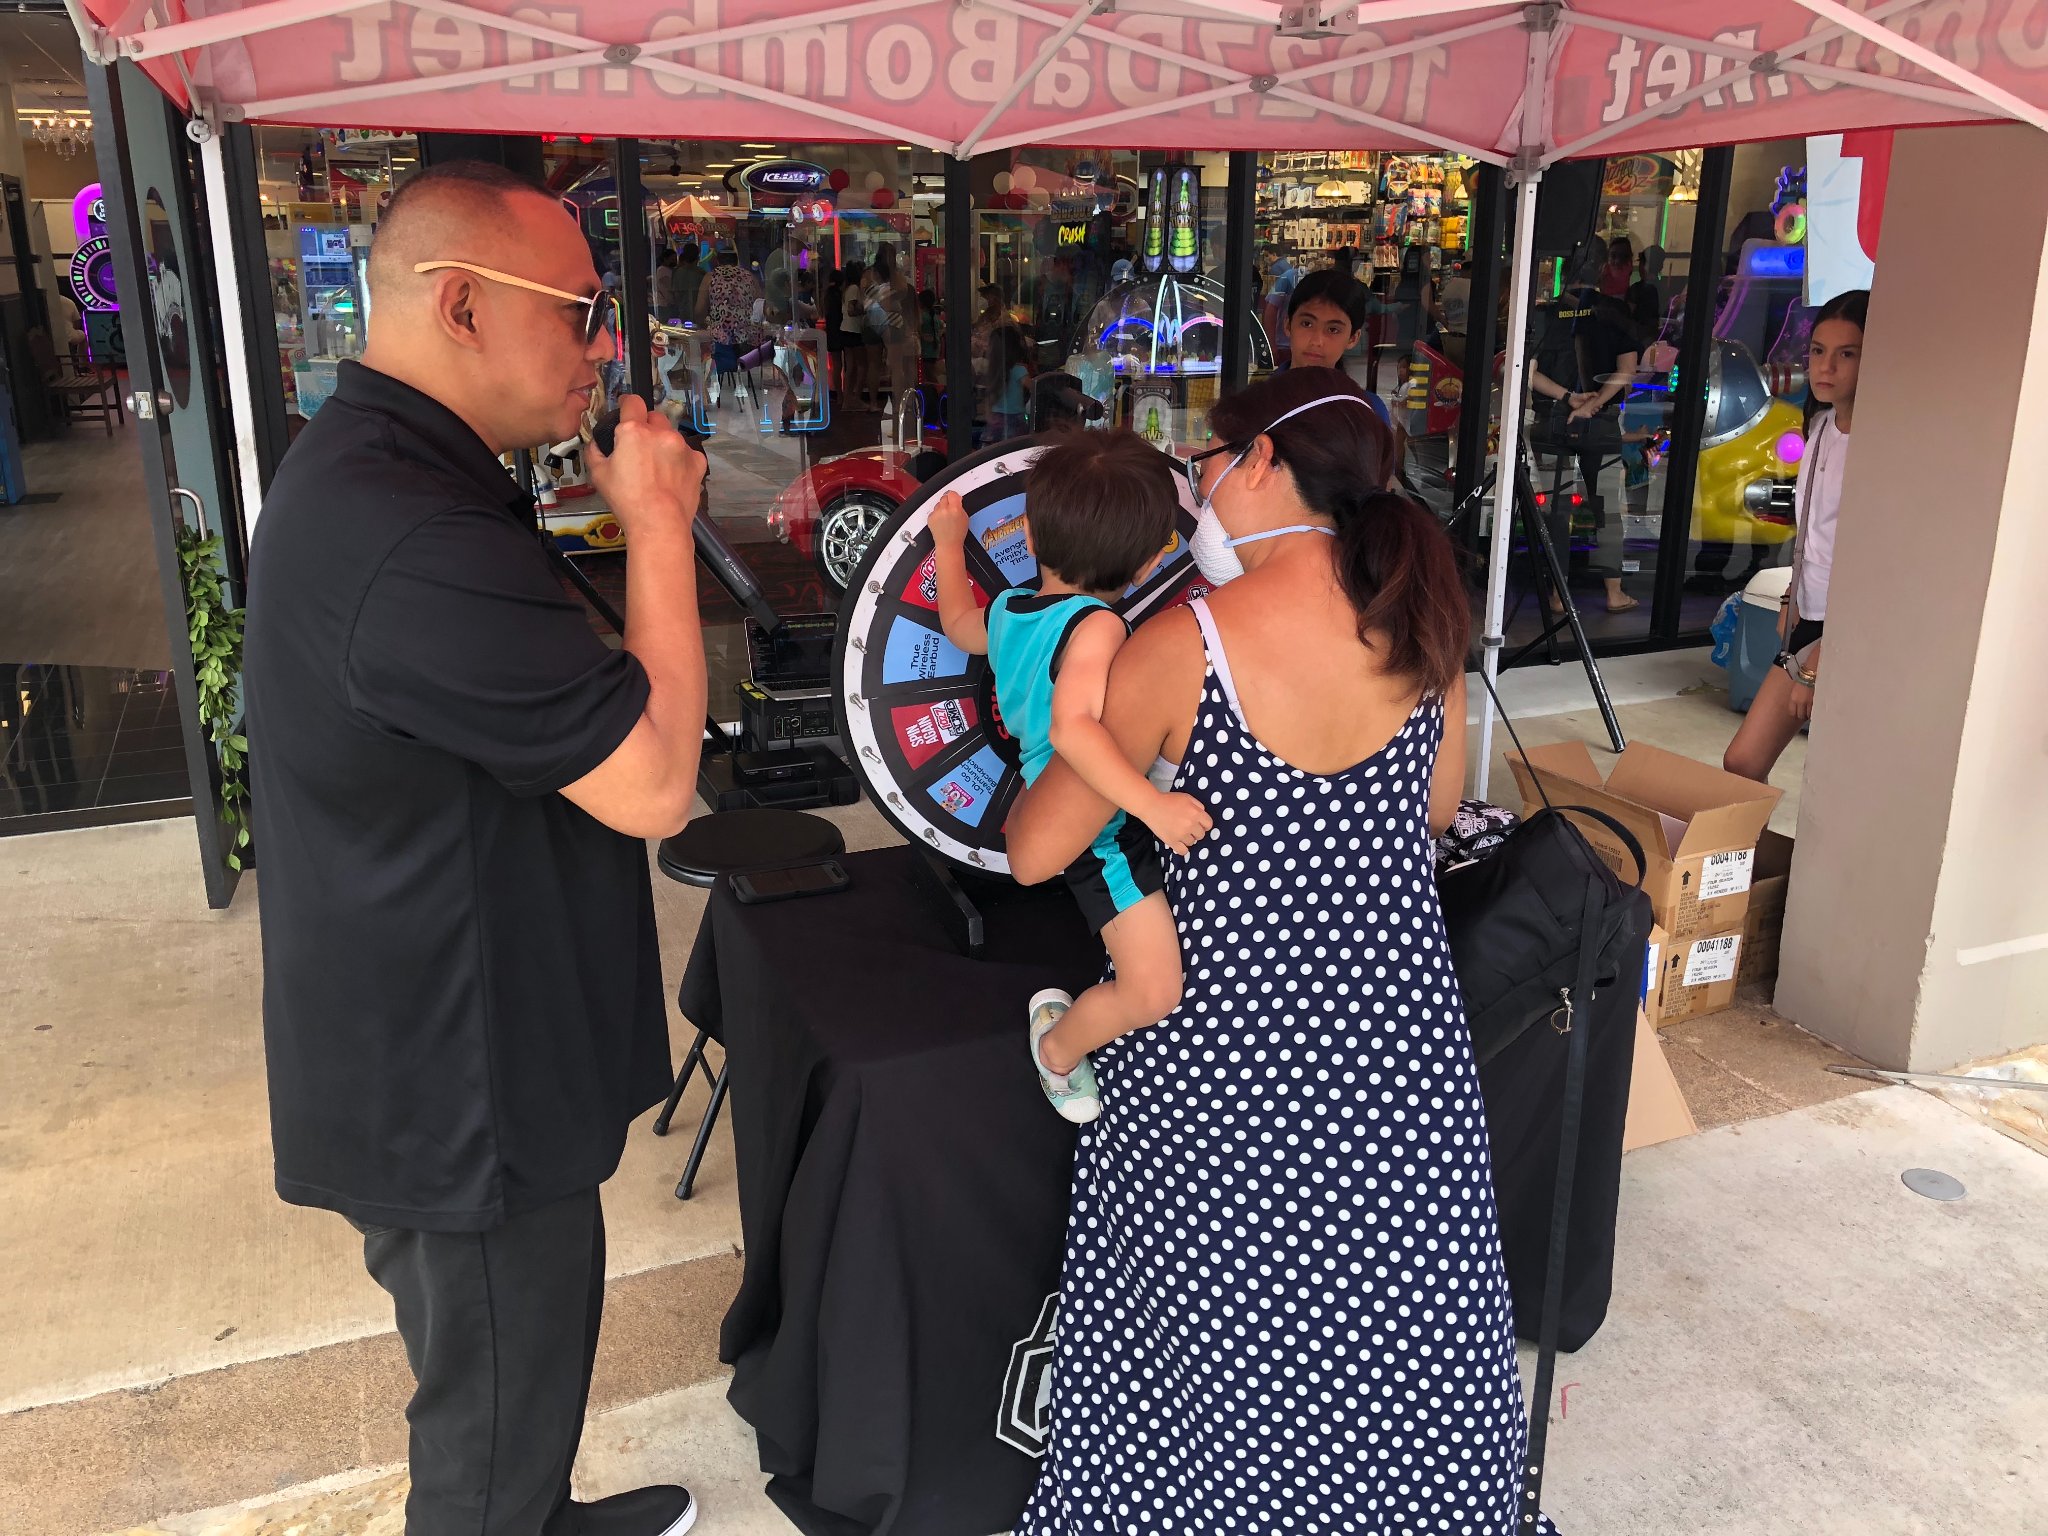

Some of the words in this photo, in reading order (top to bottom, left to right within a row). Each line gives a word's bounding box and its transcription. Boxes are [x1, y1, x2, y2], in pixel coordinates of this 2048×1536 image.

[1058, 222, 1086, 246] CRUSH
[1558, 310, 1574, 318] BOSS
[1575, 308, 1592, 317] LADY
[994, 540, 1026, 560] Avenge
[995, 549, 1023, 567] nfinity
[1010, 553, 1029, 566] Tins
[910, 644, 921, 670] True
[918, 633, 932, 680] Wireless
[927, 637, 940, 679] Earbud
[905, 724, 924, 748] SPIN
[917, 715, 940, 745] AGAIN
[960, 771, 971, 783] Go
[970, 780, 984, 795] LOL
[1696, 937, 1734, 954] 00041188
